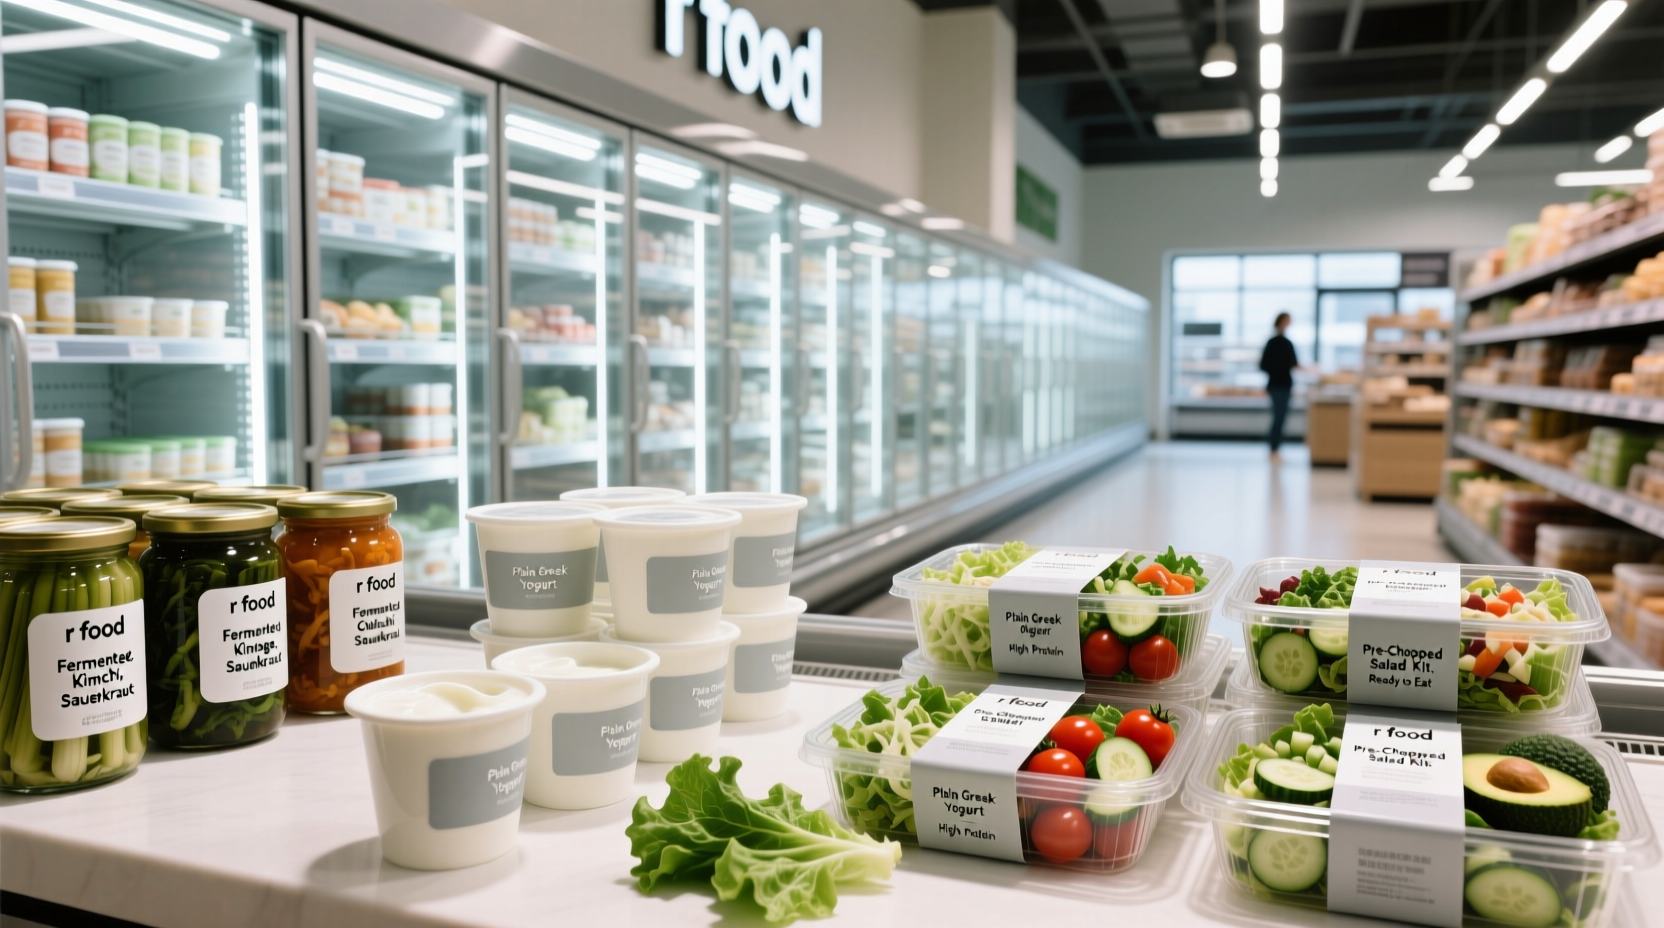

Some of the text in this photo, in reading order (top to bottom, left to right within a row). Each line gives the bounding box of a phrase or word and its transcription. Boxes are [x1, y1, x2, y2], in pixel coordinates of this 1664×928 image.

[660, 0, 823, 128] r food
[357, 572, 395, 593] r food
[519, 579, 558, 593] Yogurt
[230, 590, 275, 614] r food
[66, 614, 125, 643] r food
[1370, 658, 1406, 671] Salad
[1369, 674, 1400, 688] Ready
[1414, 677, 1432, 688] Eat
[1374, 726, 1432, 740] r food
[944, 802, 985, 818] Yogurt
